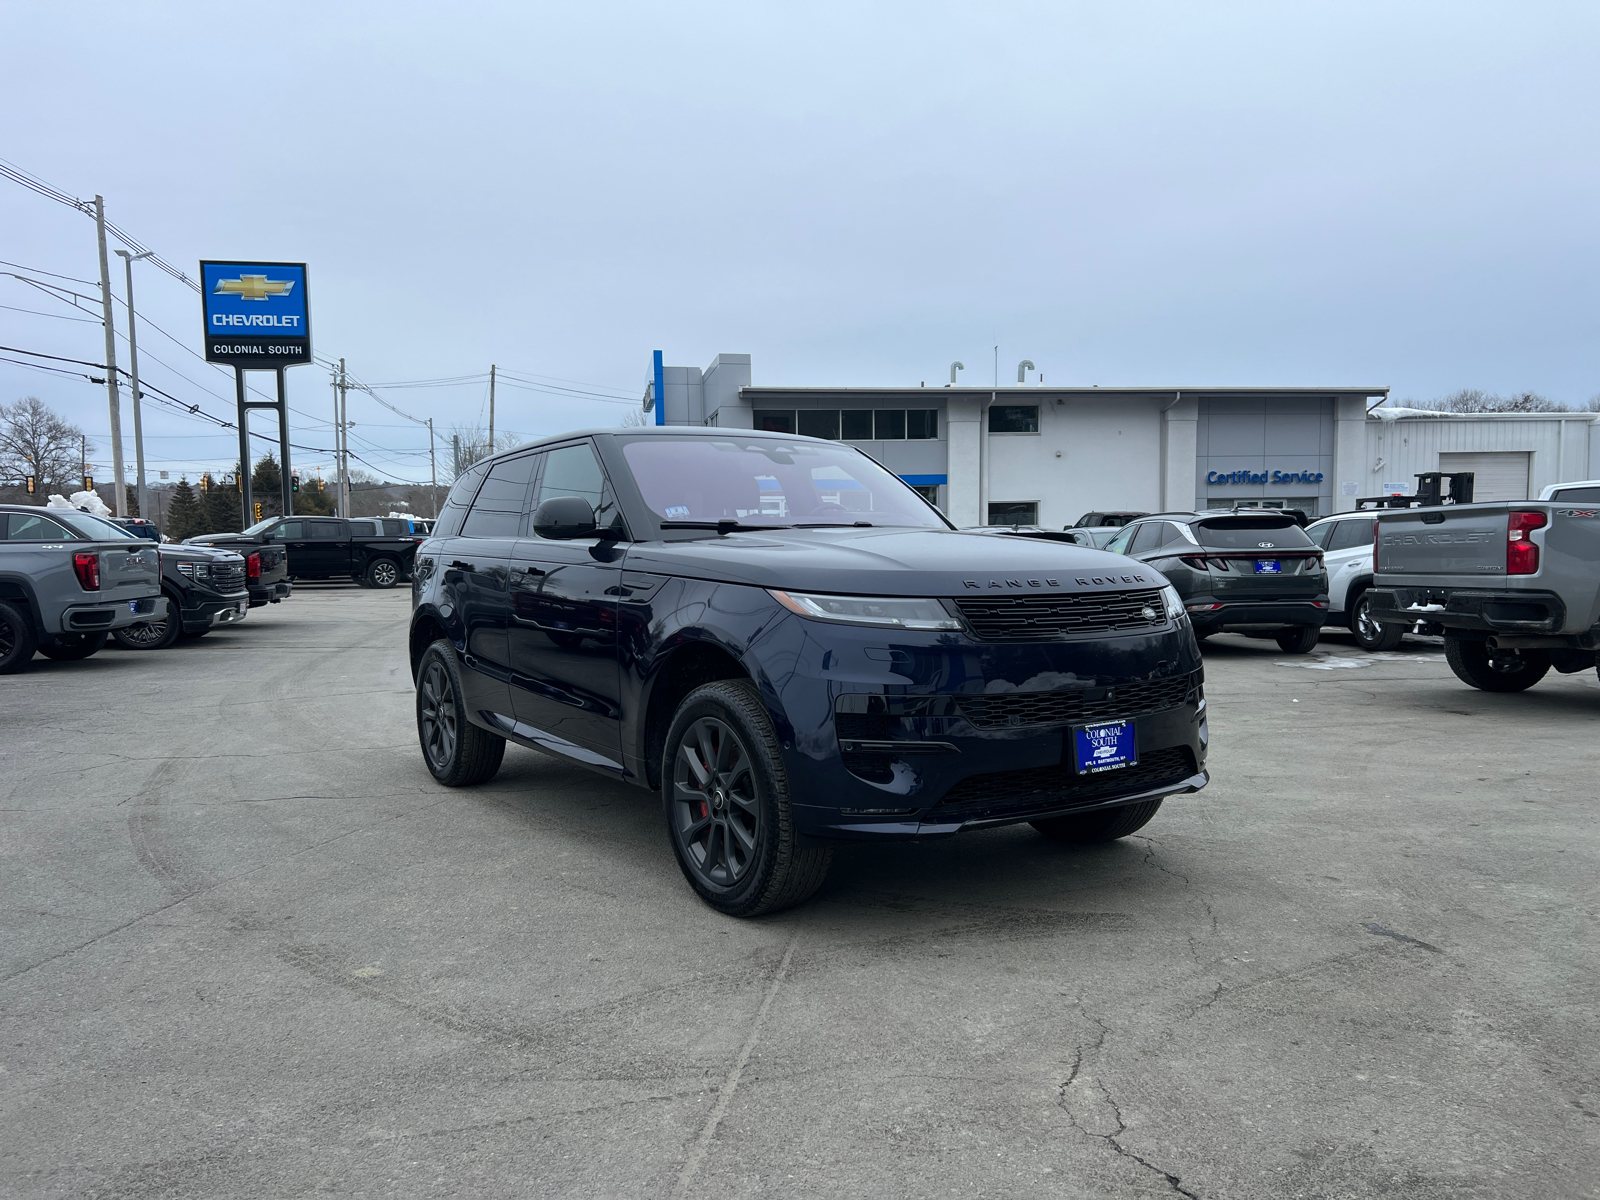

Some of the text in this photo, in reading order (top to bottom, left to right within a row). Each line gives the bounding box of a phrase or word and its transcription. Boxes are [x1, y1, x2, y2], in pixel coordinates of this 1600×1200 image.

[213, 314, 300, 327] CHEVROLET
[214, 345, 302, 355] COLONIAL SOUTH
[1207, 470, 1324, 484] Certified Service
[1383, 531, 1496, 546] CHEVROLET
[962, 574, 1146, 589] RANGE ROVER
[1086, 727, 1123, 739] COLONIAL
[1092, 736, 1117, 747] SOUTH
